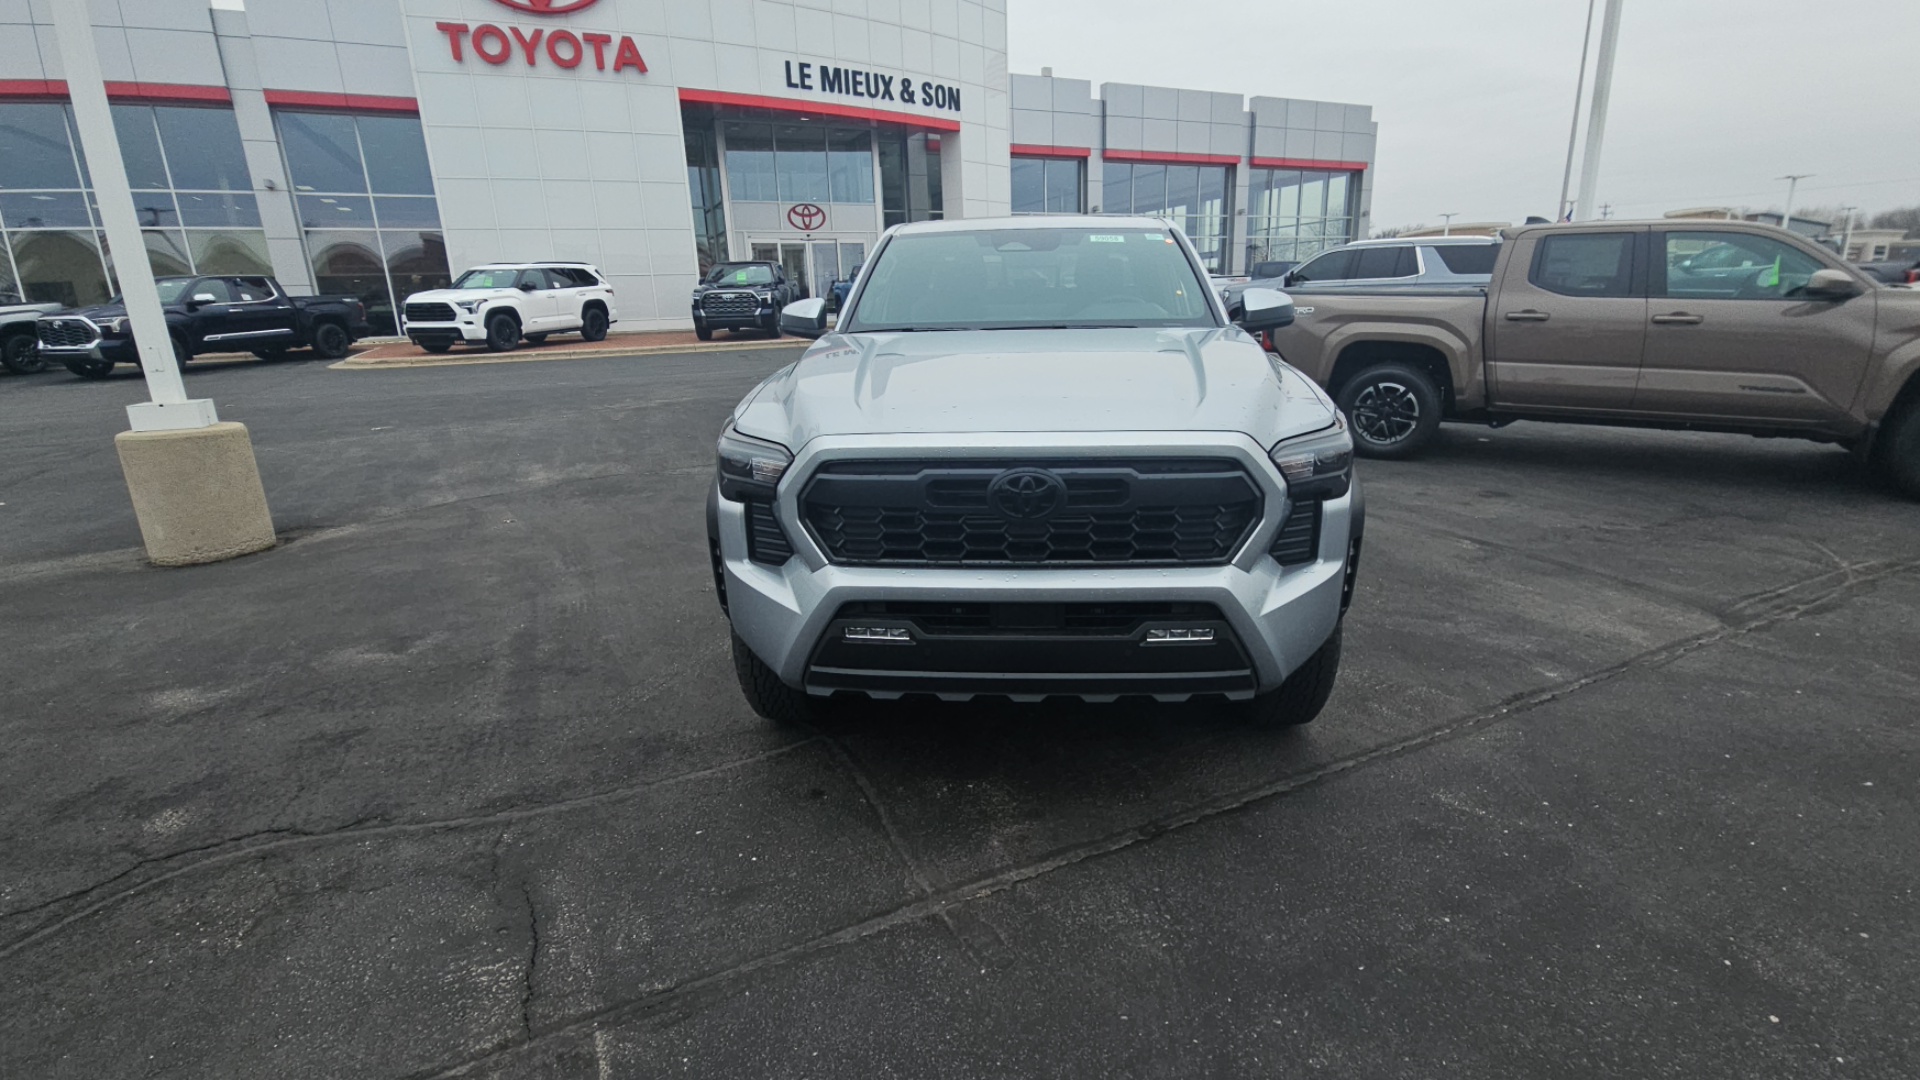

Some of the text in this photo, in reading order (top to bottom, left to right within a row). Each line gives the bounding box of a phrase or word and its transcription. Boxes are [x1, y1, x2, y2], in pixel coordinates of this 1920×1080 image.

[435, 21, 648, 73] TOYOTA
[785, 60, 961, 112] LE MIEUX & SON
